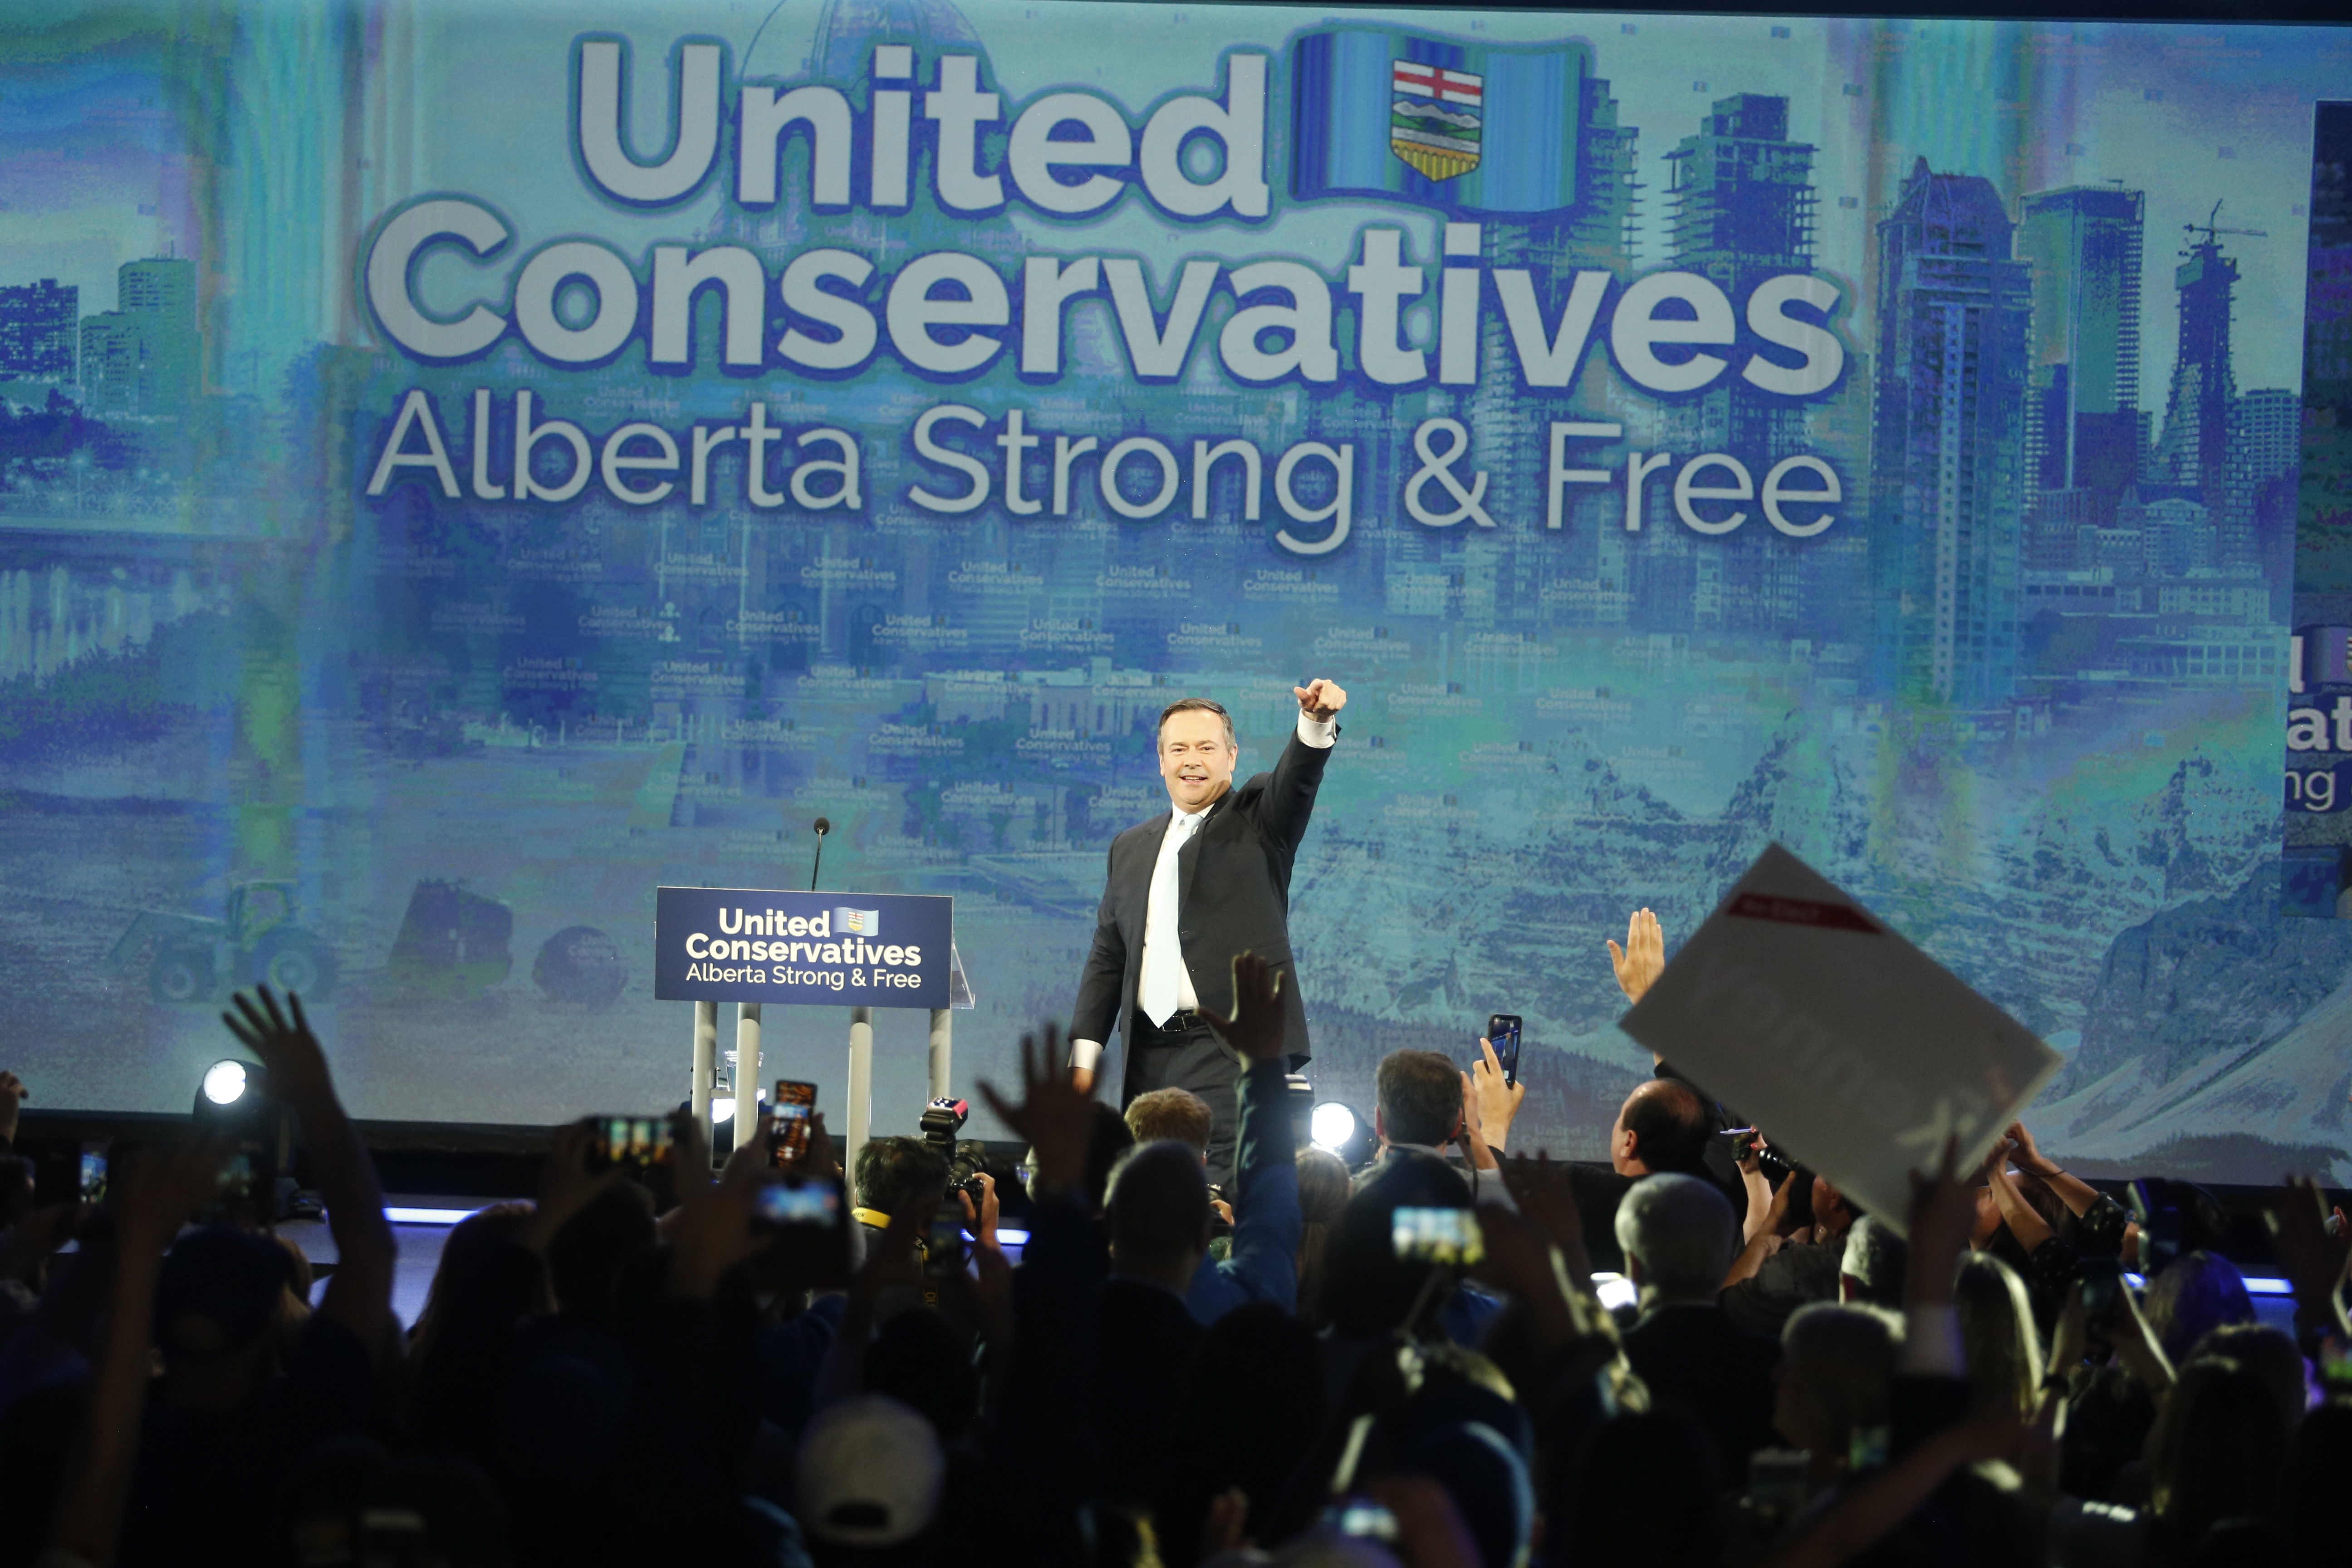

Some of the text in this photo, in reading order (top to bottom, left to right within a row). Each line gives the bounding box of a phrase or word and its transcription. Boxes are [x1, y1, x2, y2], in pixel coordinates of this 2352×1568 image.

[580, 41, 1269, 216] United
[367, 199, 1845, 395] Conservatives
[365, 389, 1842, 554] Alberta Strong & Free
[685, 932, 922, 966] Conservatives
[719, 907, 831, 938] United
[685, 963, 922, 991] Alberta Strong & Free
